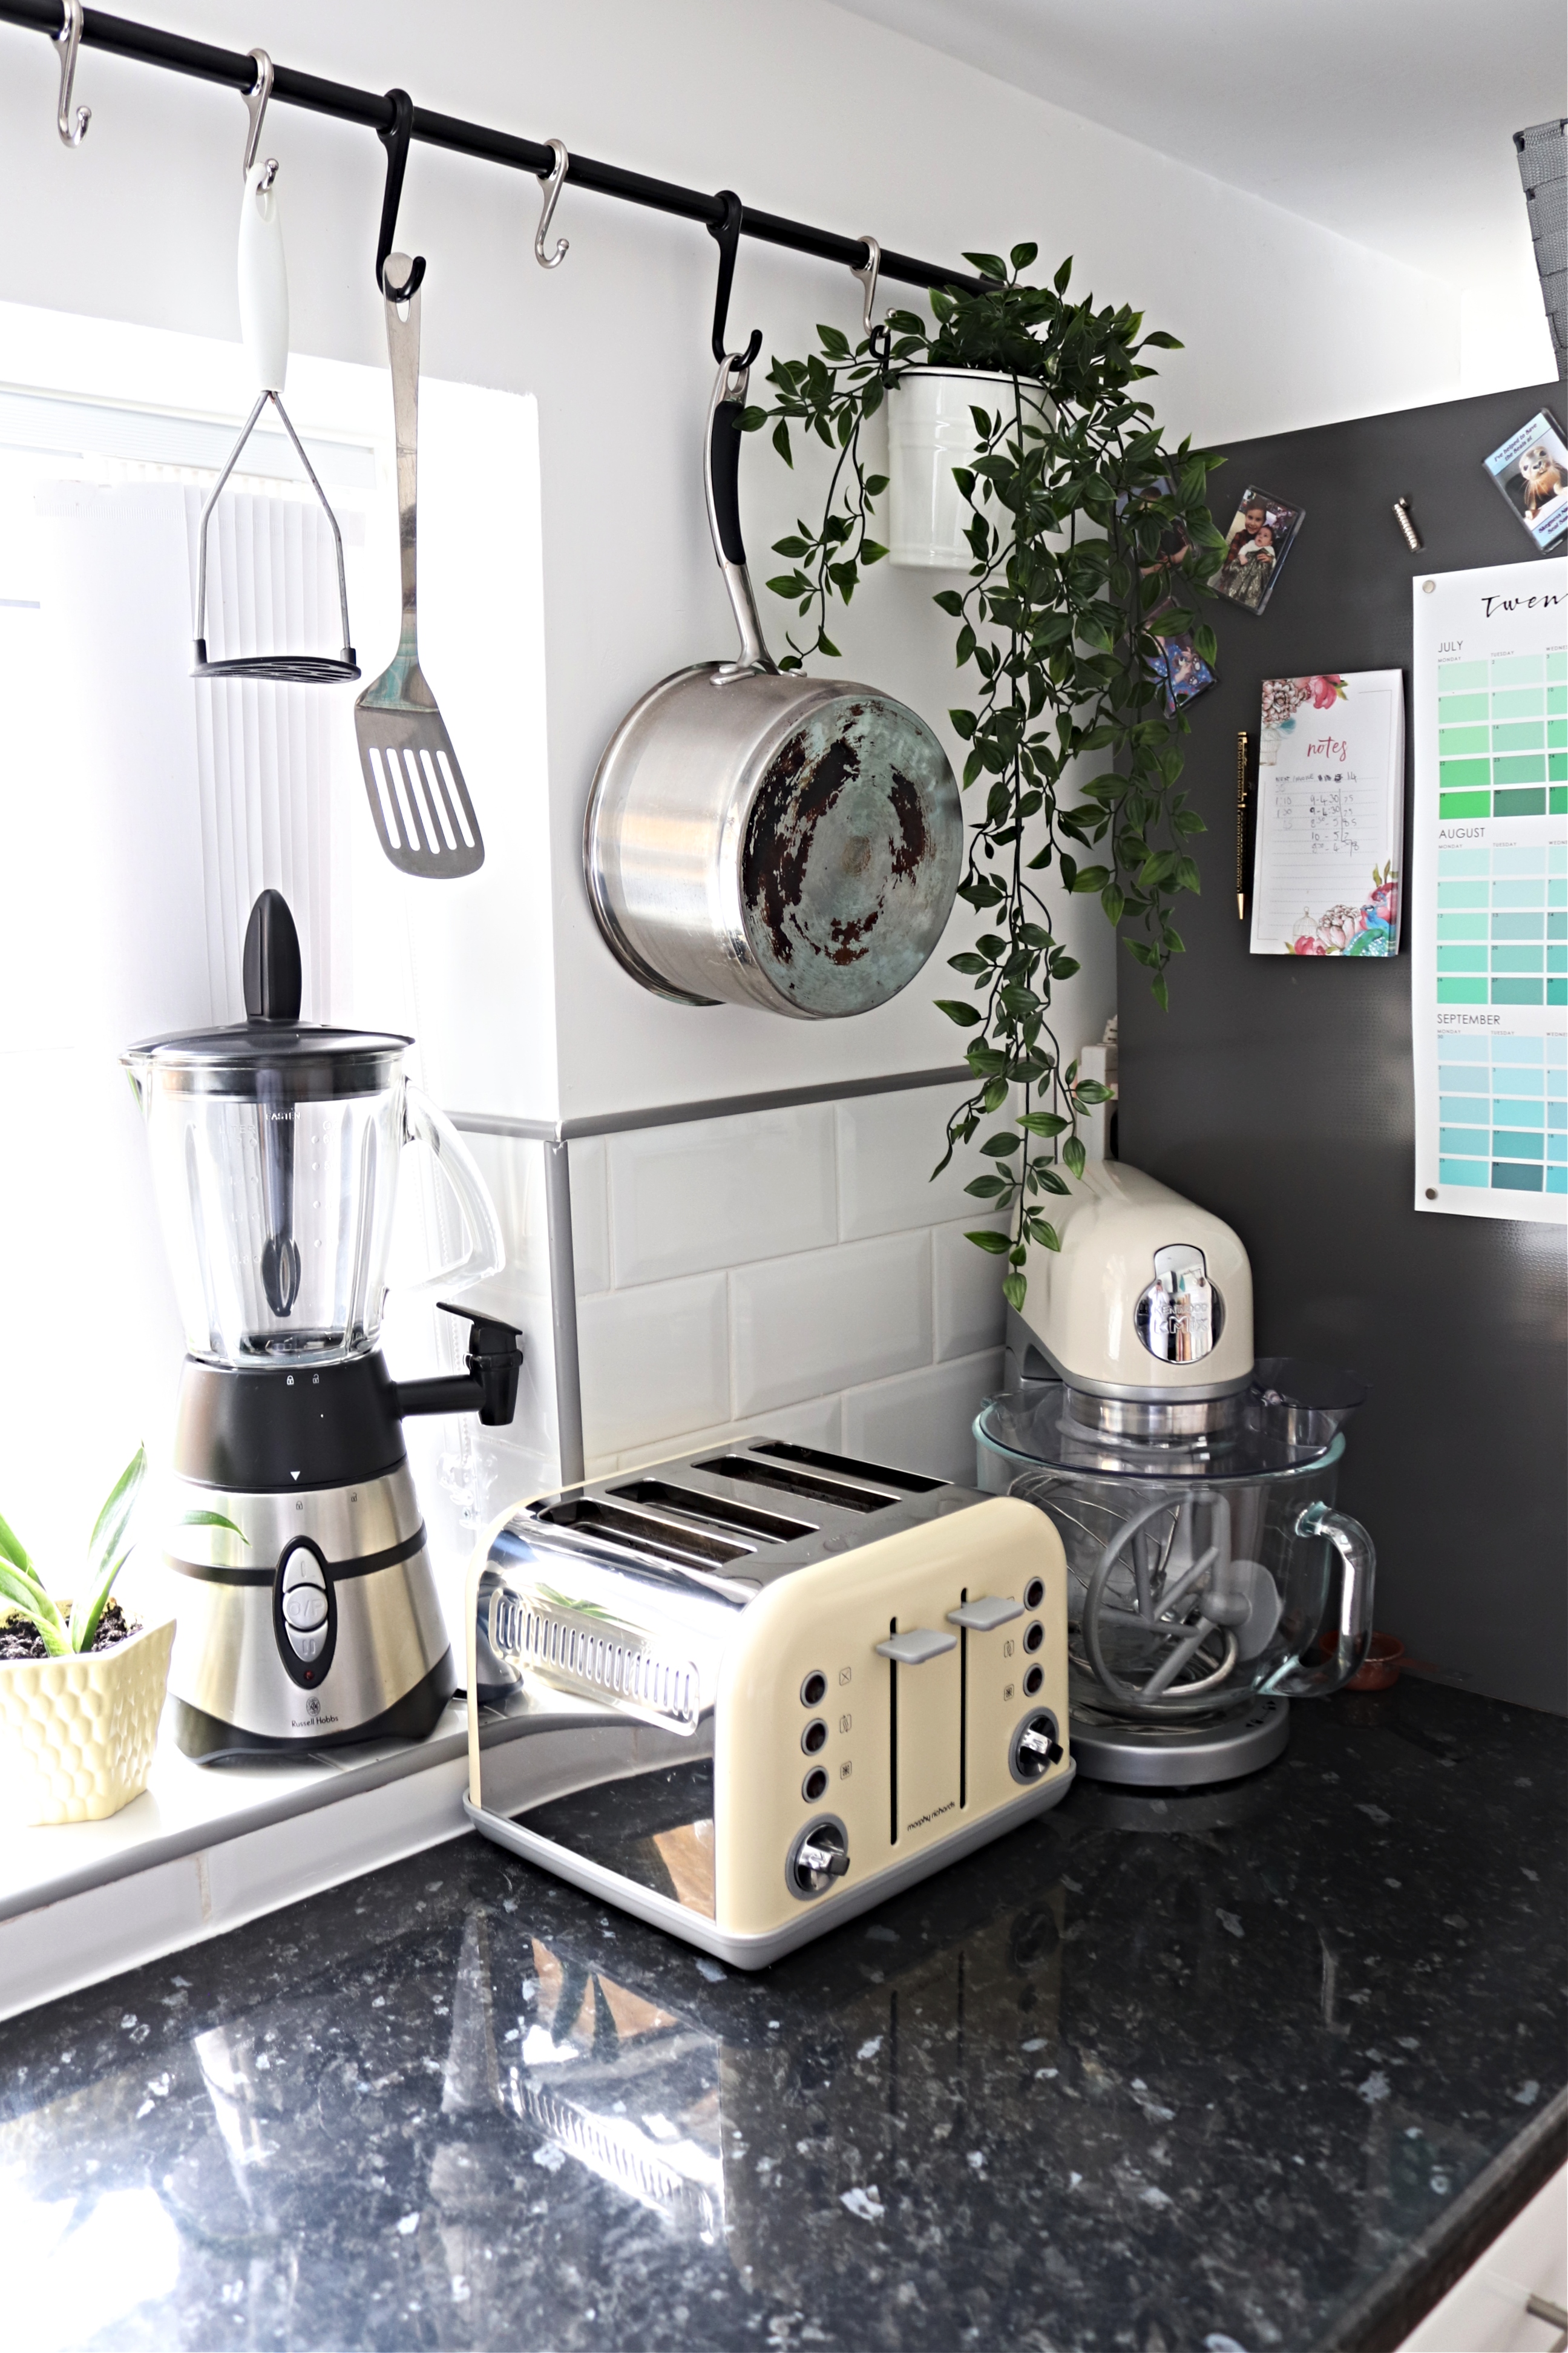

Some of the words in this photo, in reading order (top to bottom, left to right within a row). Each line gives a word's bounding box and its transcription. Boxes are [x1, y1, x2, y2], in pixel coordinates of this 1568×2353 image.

[1503, 438, 1520, 454] helped
[1526, 424, 1537, 435] Save
[1514, 441, 1526, 453] Seals
[1438, 640, 1463, 653] JULY
[1307, 736, 1347, 762] notes
[1438, 828, 1485, 838] AUGUST
[1437, 1014, 1500, 1025] SEPTEMBER
[266, 1111, 301, 1121] FASTEN
[1154, 1303, 1208, 1314] KENWOOD
[292, 1717, 315, 1728] Russell
[316, 1715, 339, 1725] Hobbs
[907, 1814, 931, 1832] morphy
[931, 1800, 955, 1819] richards
